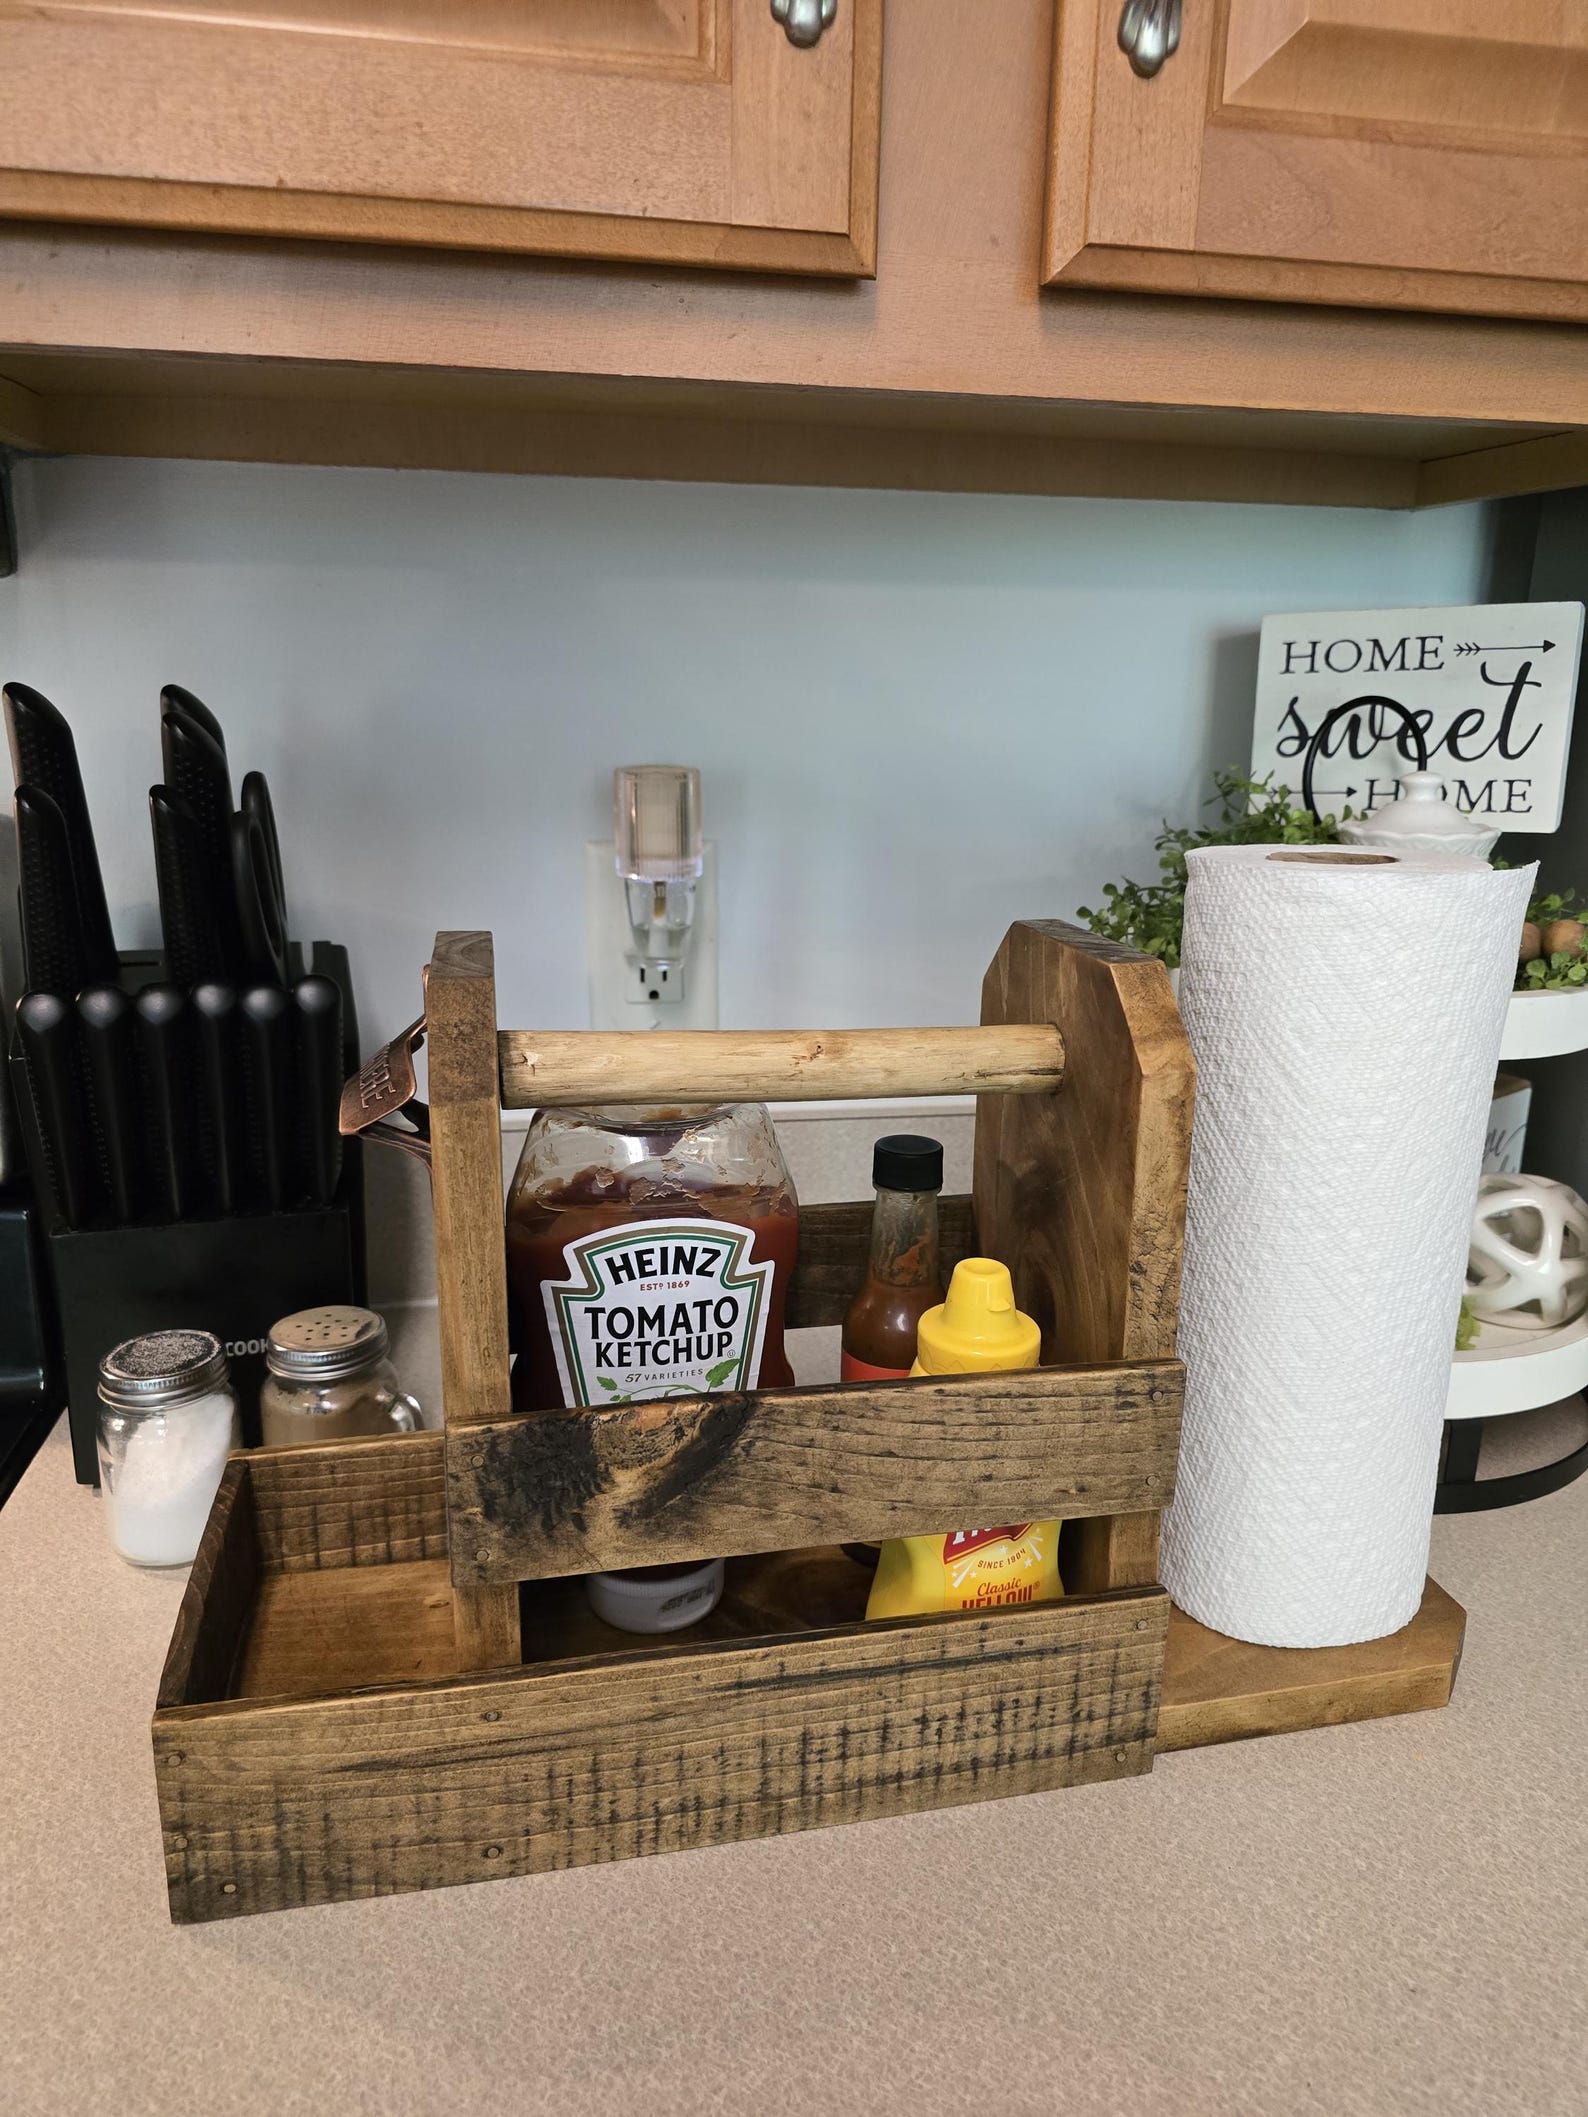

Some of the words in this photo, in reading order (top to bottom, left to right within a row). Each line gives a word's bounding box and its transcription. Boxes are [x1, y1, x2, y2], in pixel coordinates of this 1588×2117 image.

[1279, 635, 1445, 675] HOME
[1275, 661, 1543, 763] sweet
[1364, 778, 1533, 814] HME
[604, 1245, 722, 1286] HEINZ
[667, 1280, 690, 1289] 1869
[583, 1295, 740, 1340] TOMATO
[595, 1330, 734, 1368] KETCHUP
[624, 1373, 641, 1383] 57
[644, 1368, 704, 1381] VARIETIES
[977, 1559, 1004, 1570] SINCE
[1007, 1547, 1026, 1566] 1904
[977, 1577, 1022, 1597] Classic
